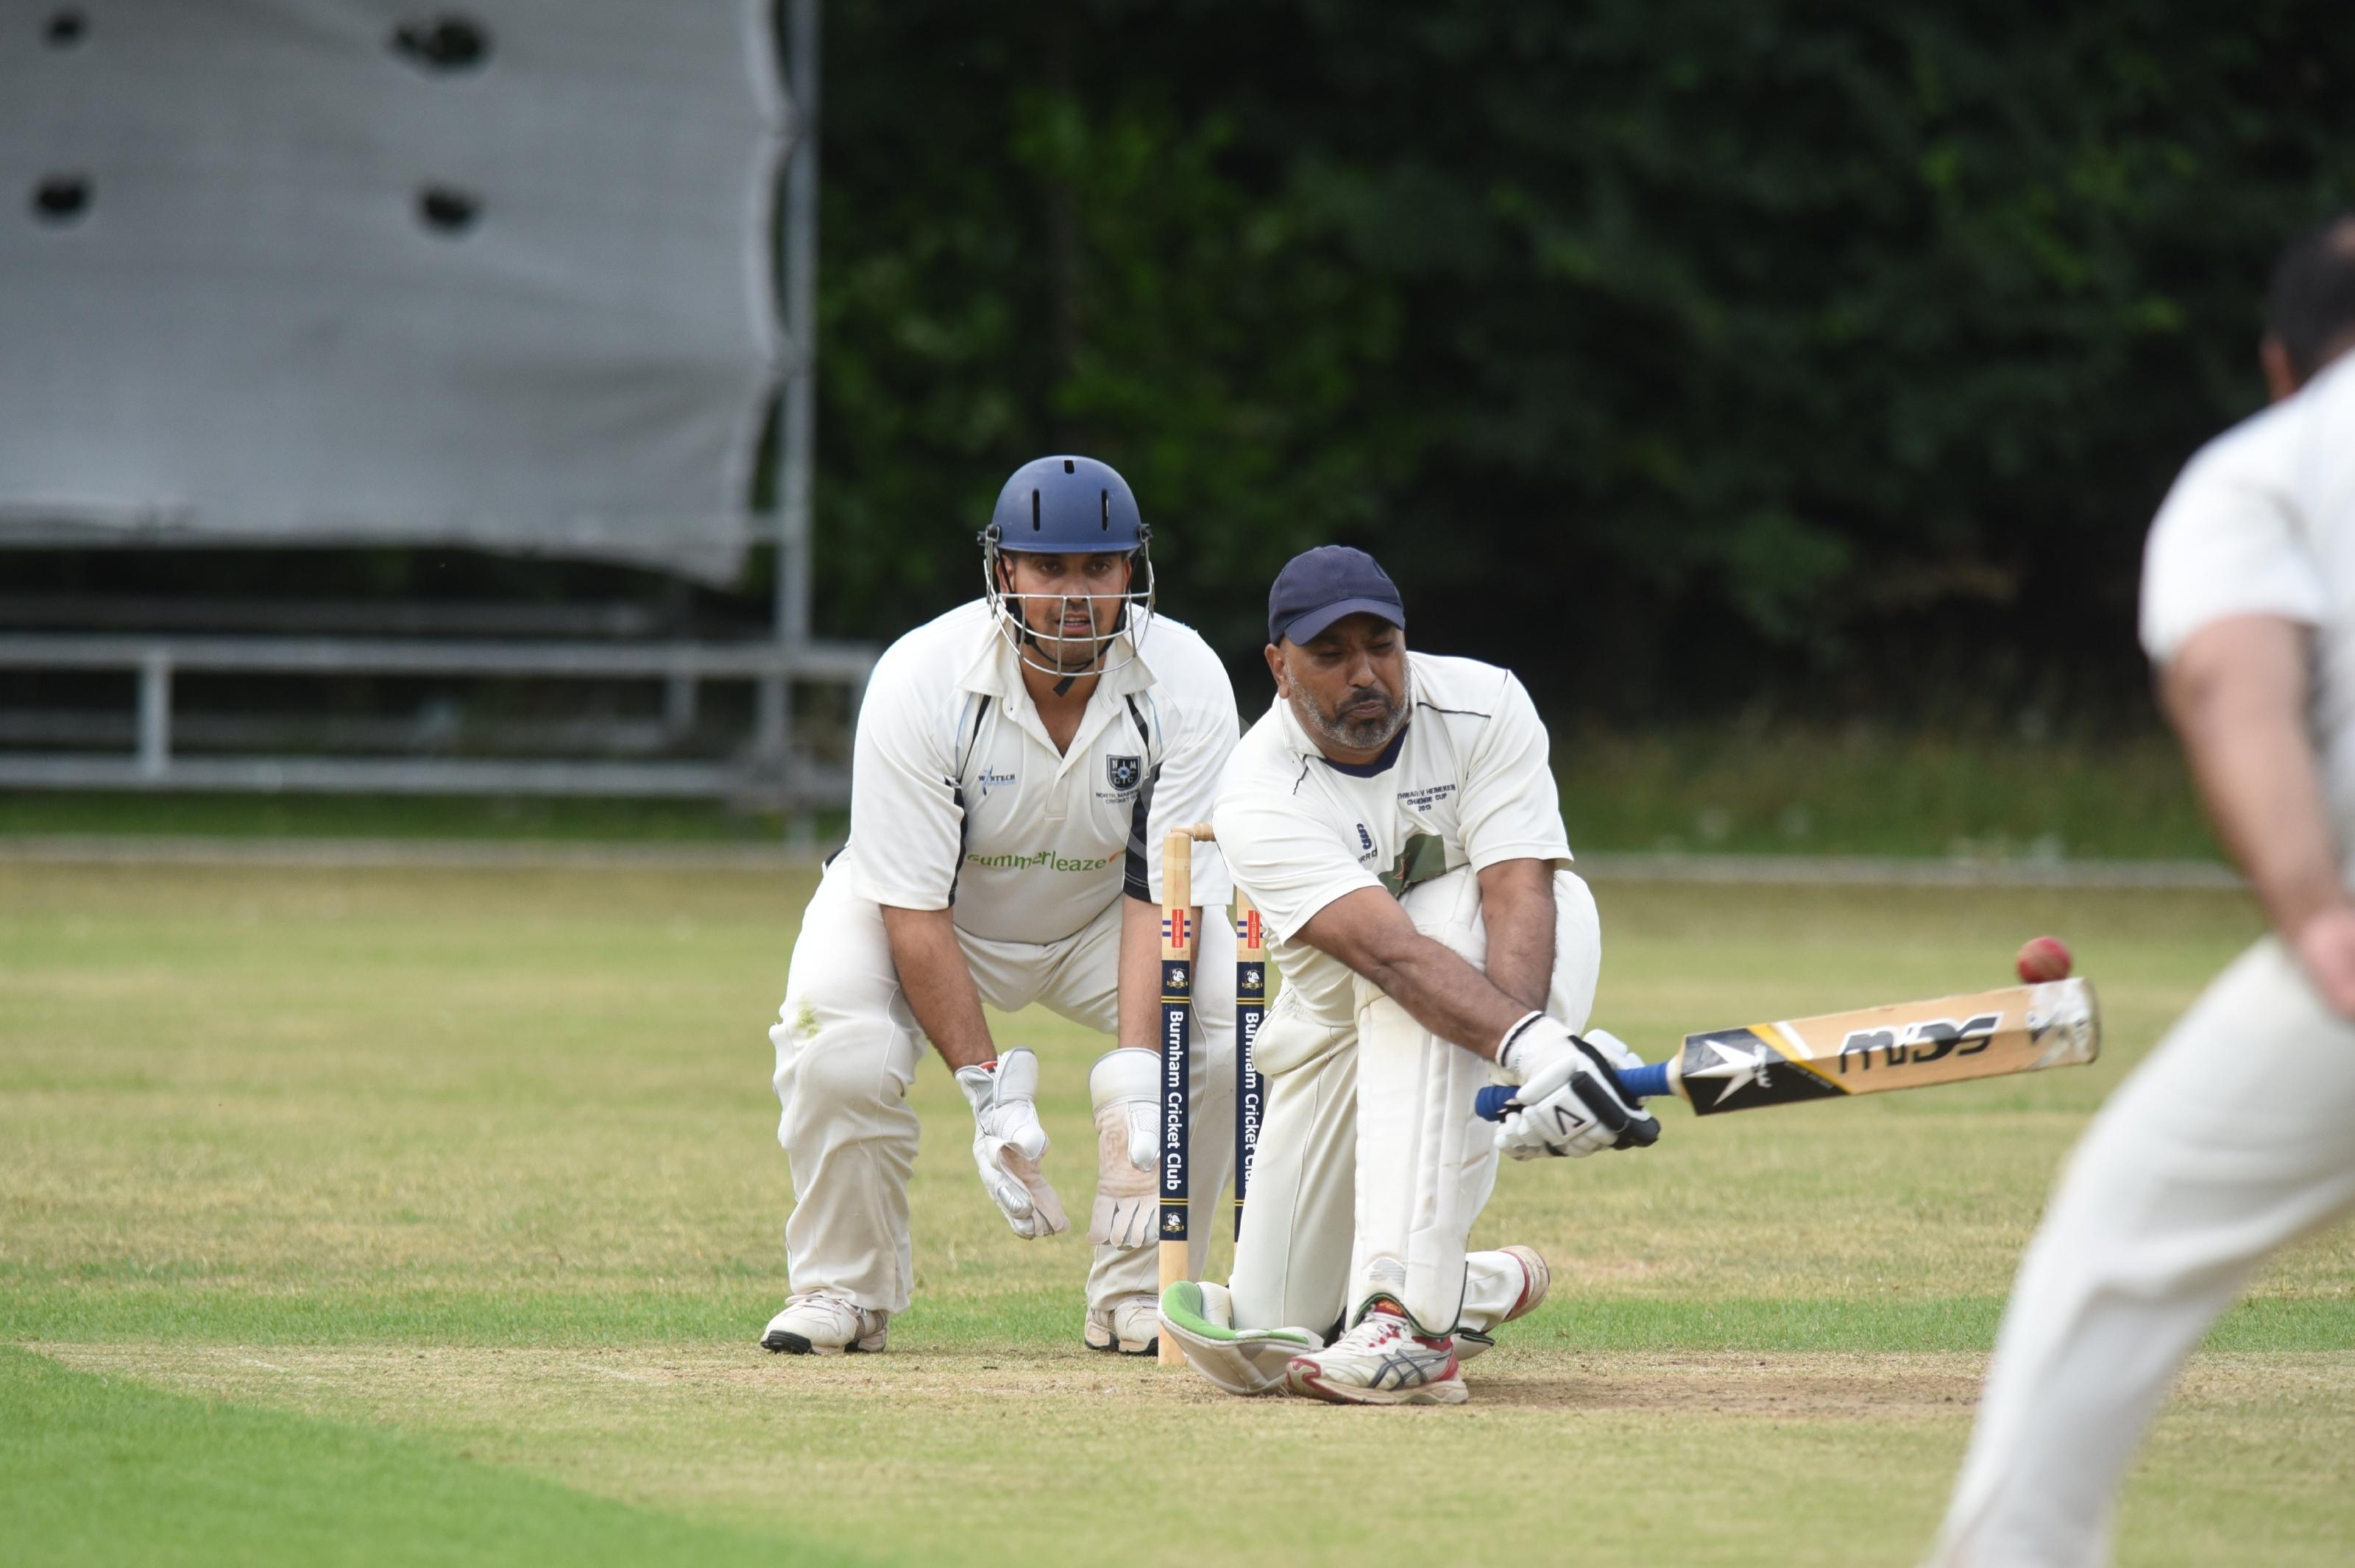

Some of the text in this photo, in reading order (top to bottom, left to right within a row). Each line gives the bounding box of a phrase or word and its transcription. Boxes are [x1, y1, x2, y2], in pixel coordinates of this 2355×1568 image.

[967, 850, 1107, 872] summerleaze
[1166, 1010, 1183, 1191] Burnham Cricket Club
